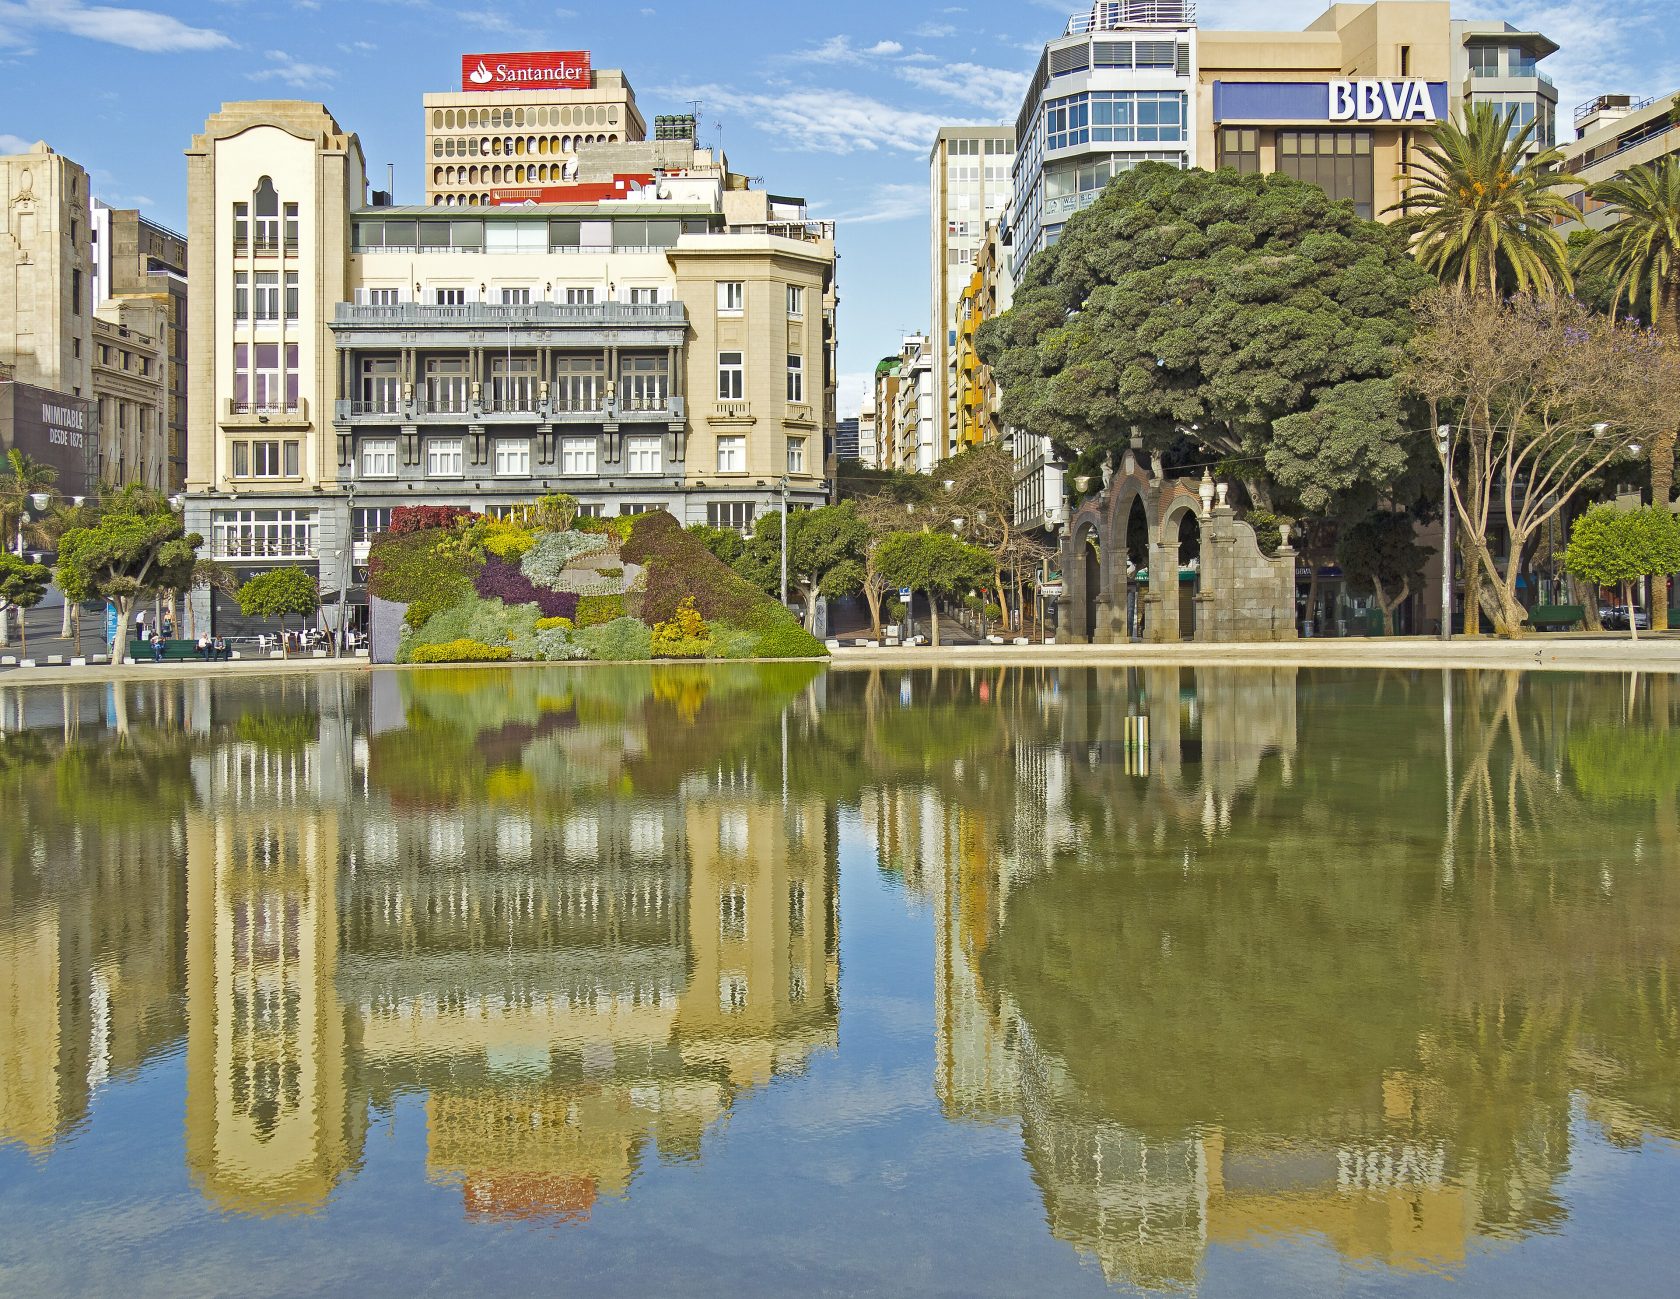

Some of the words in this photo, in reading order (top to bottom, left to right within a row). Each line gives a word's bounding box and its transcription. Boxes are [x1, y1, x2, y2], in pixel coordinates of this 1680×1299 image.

[496, 61, 583, 82] Santander
[1328, 80, 1436, 121] BBVA
[42, 403, 83, 430] INIMITABLE
[50, 428, 68, 446] DESDE
[70, 431, 83, 448] 1873
